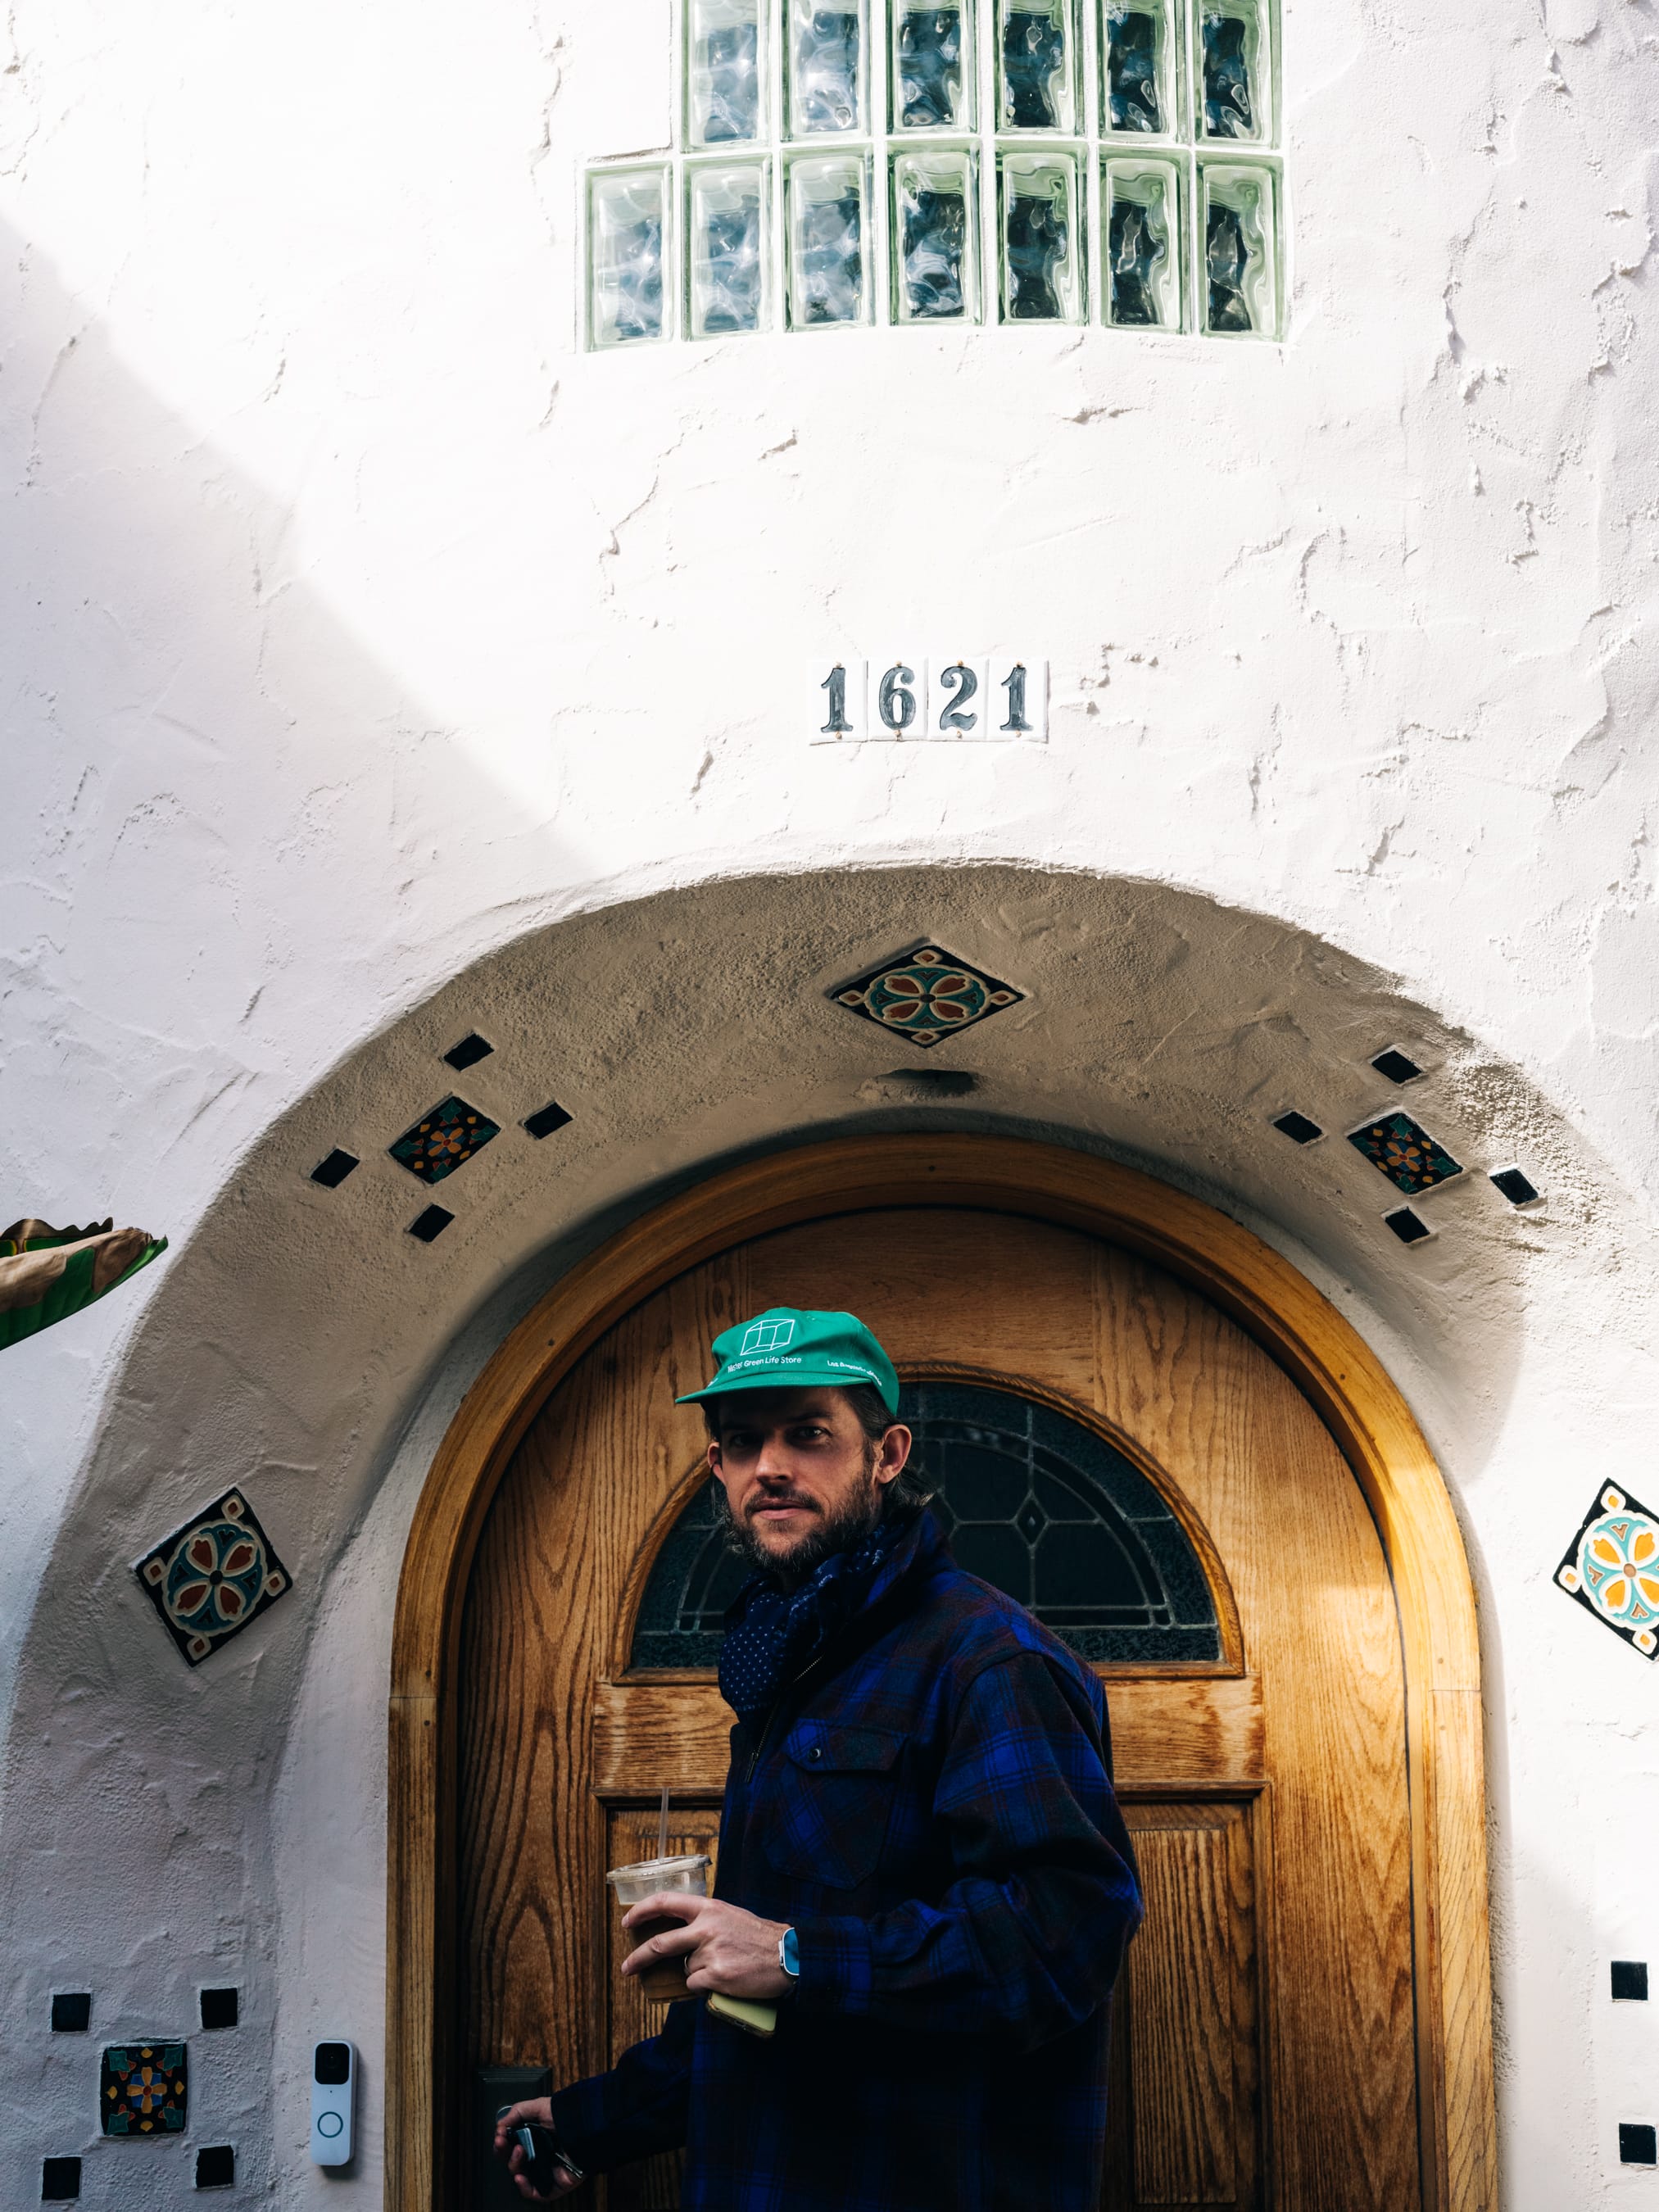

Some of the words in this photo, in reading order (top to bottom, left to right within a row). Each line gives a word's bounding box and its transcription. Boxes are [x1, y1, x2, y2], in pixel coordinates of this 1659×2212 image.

[820, 665, 1034, 732] 1621
[744, 1358, 764, 1367] Green
[764, 1356, 779, 1364] Life
[781, 1356, 802, 1364] Store
